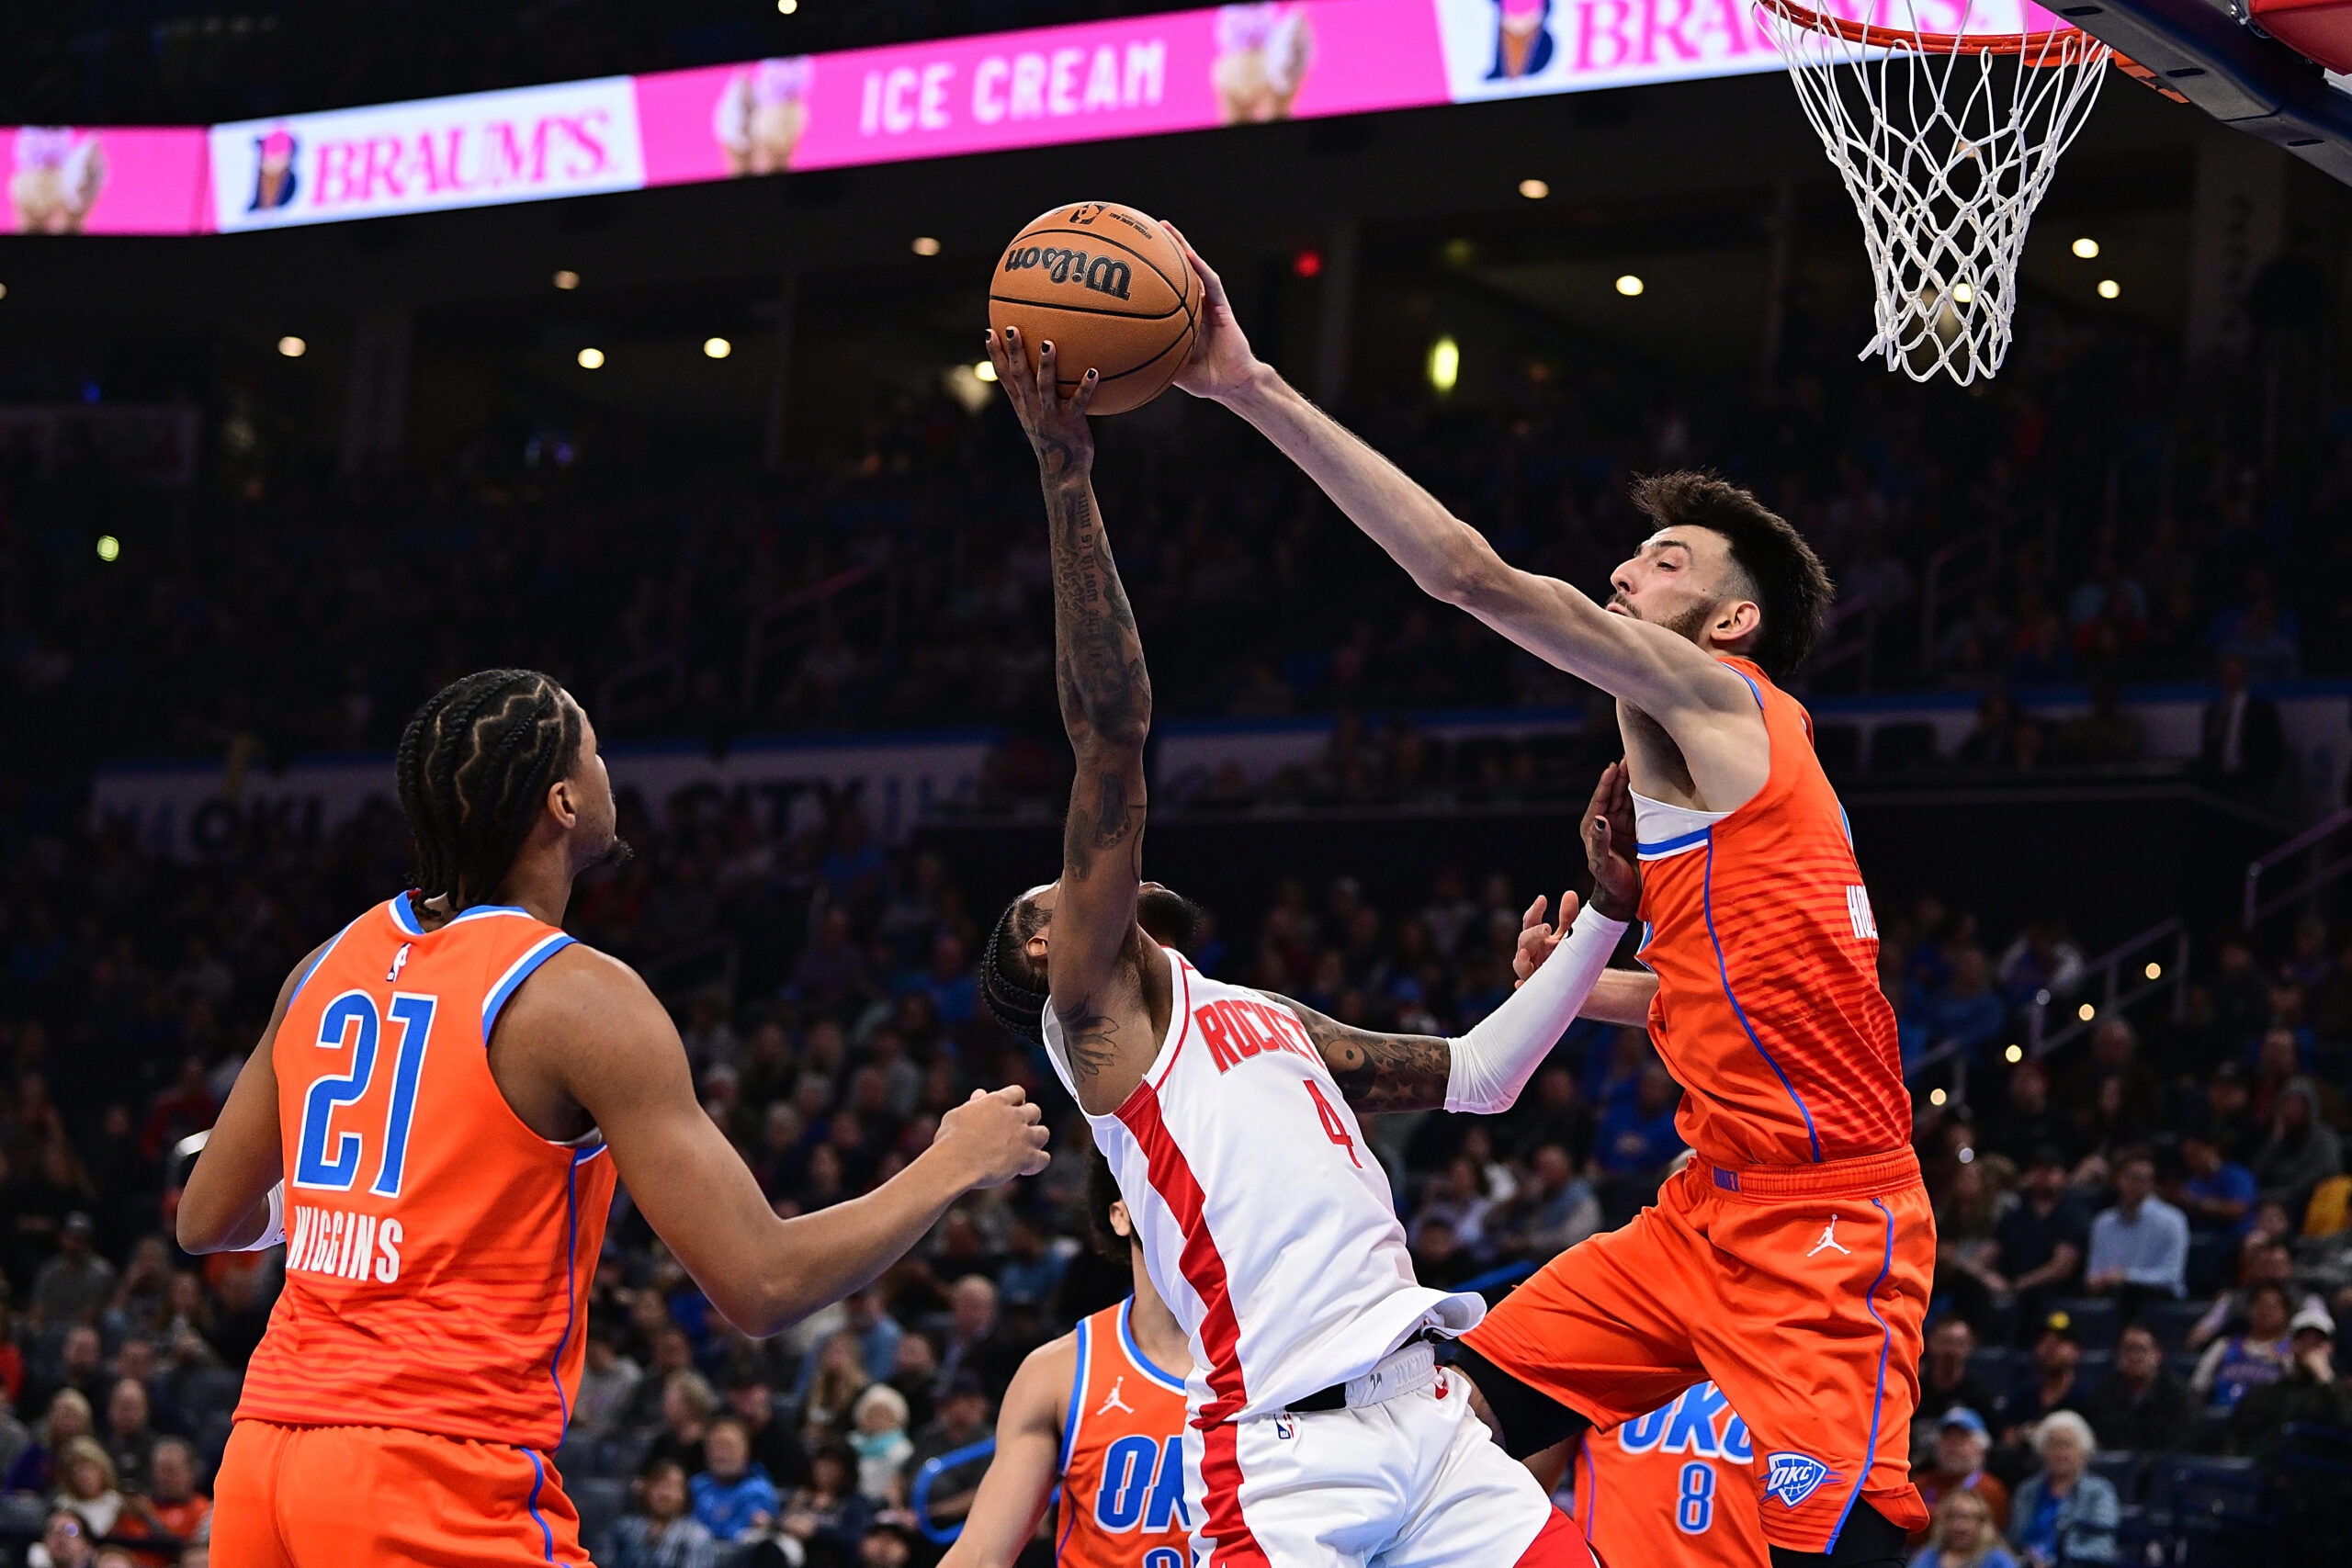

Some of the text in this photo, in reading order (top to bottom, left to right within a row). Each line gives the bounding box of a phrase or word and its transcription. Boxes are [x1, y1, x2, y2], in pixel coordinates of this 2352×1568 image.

[858, 38, 1168, 137] ICE CREAM
[311, 108, 610, 207] BRAUM'S
[1005, 247, 1132, 301] Wilson
[292, 988, 438, 1199] 21
[1303, 1079, 1363, 1168] 4
[286, 1205, 403, 1283] WIGGINS
[1675, 1460, 1716, 1535] 8
[1767, 1466, 1813, 1491] OKC
